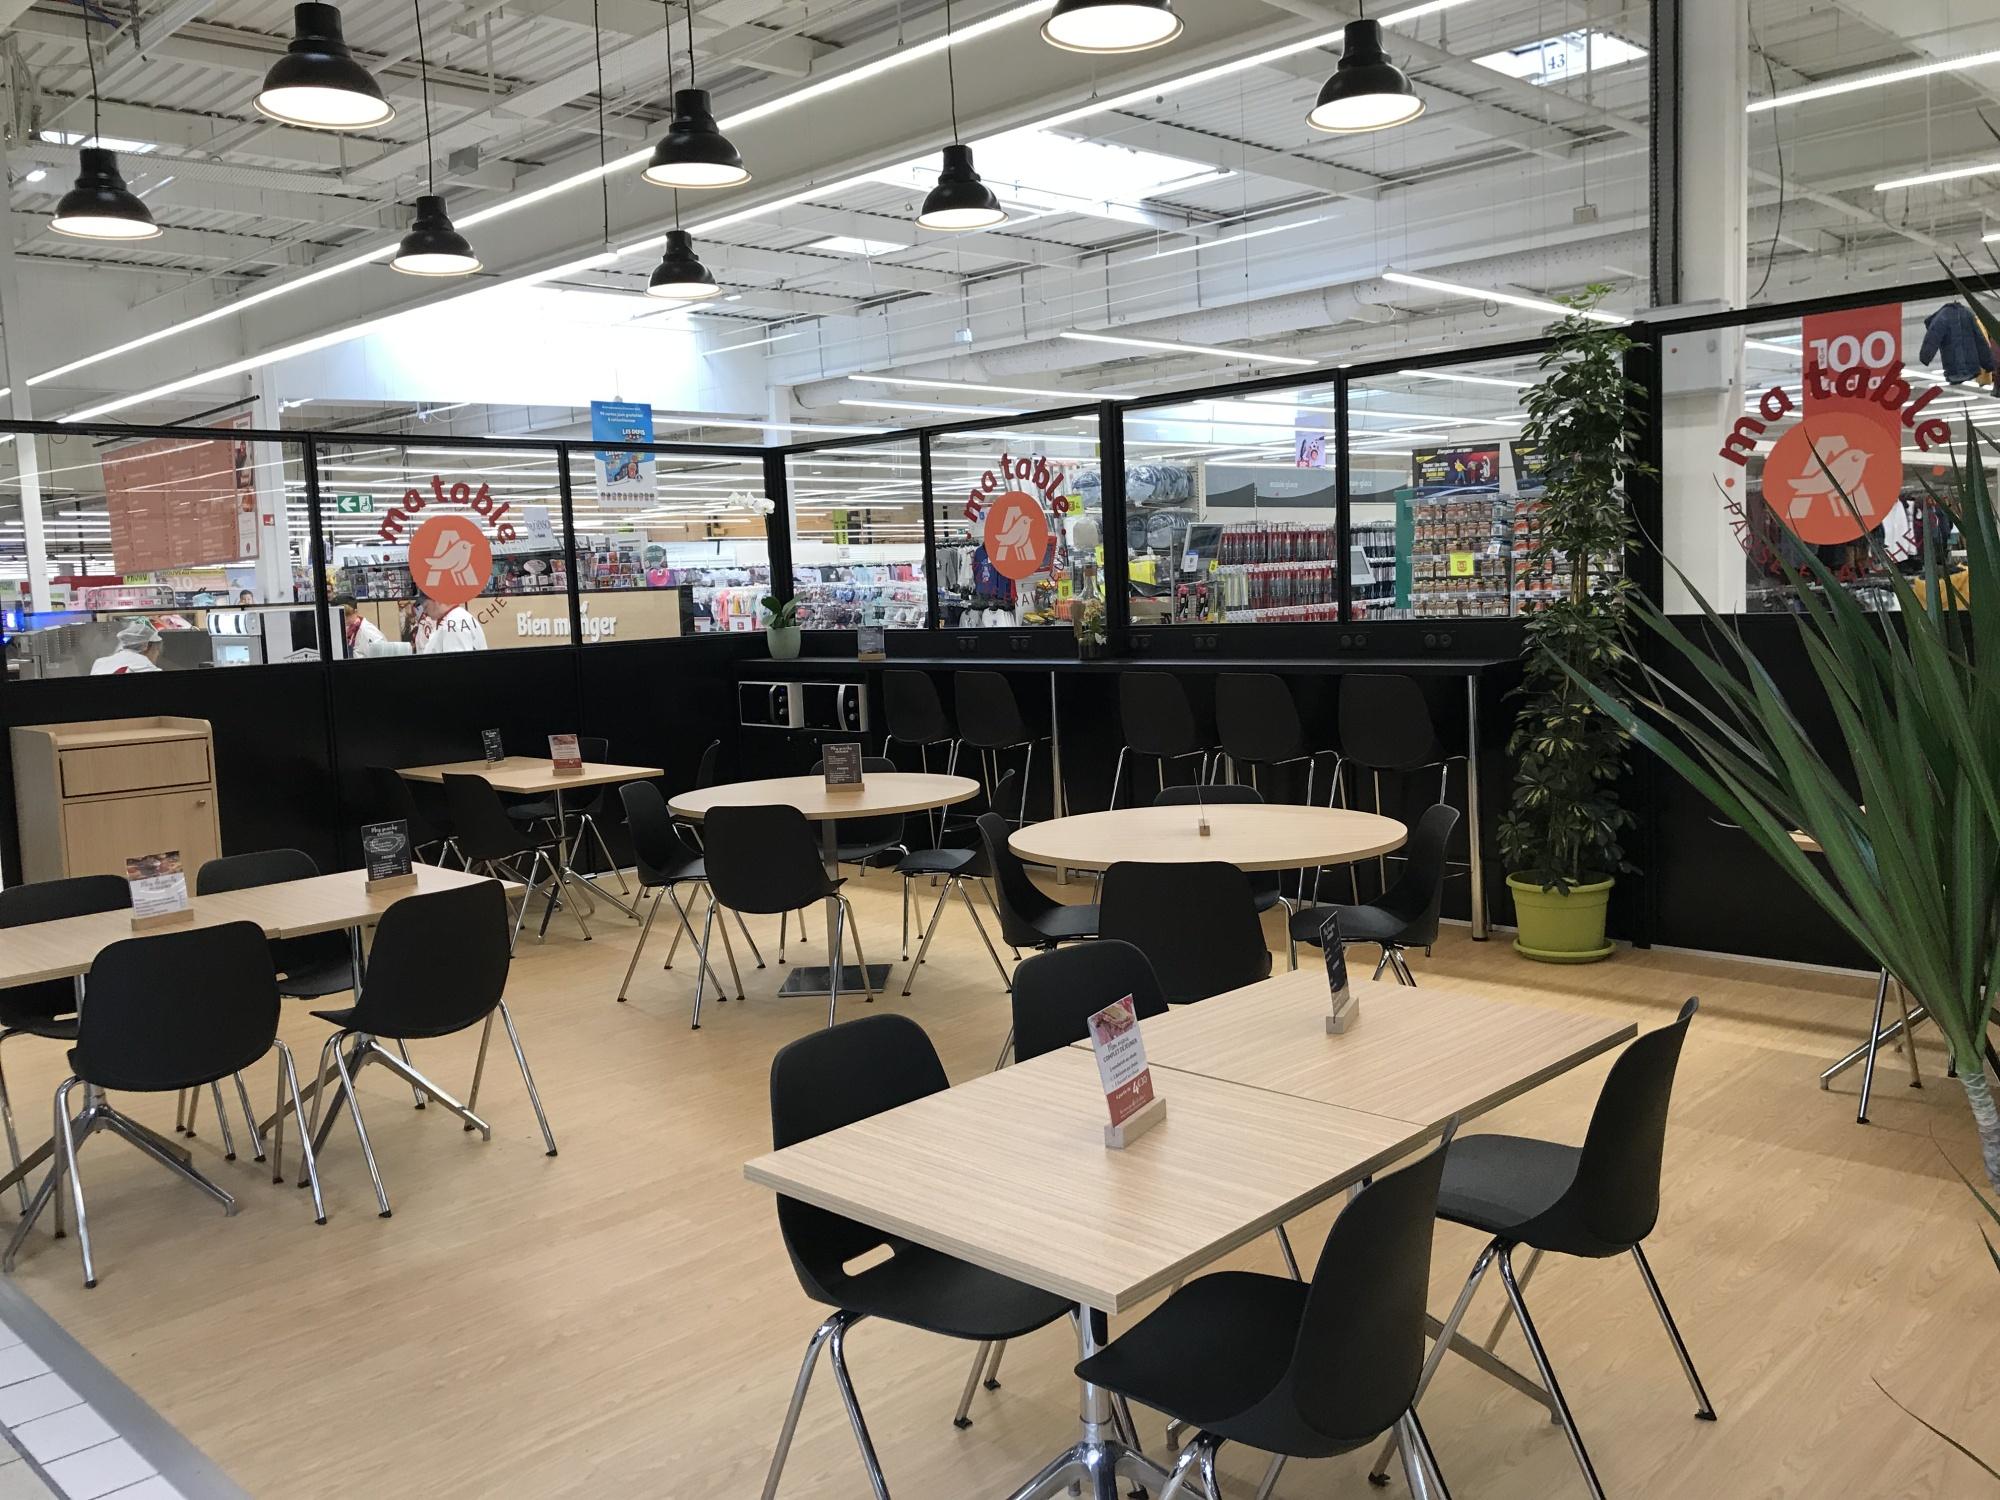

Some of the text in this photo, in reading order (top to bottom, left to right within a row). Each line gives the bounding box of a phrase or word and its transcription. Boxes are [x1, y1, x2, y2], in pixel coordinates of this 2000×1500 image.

[1547, 53, 1565, 70] 43
[1809, 330, 1896, 373] 100
[1719, 360, 1952, 467] ma table
[378, 475, 516, 545] ma table
[964, 453, 1069, 523] ma table
[516, 610, 617, 642] Bien mnger
